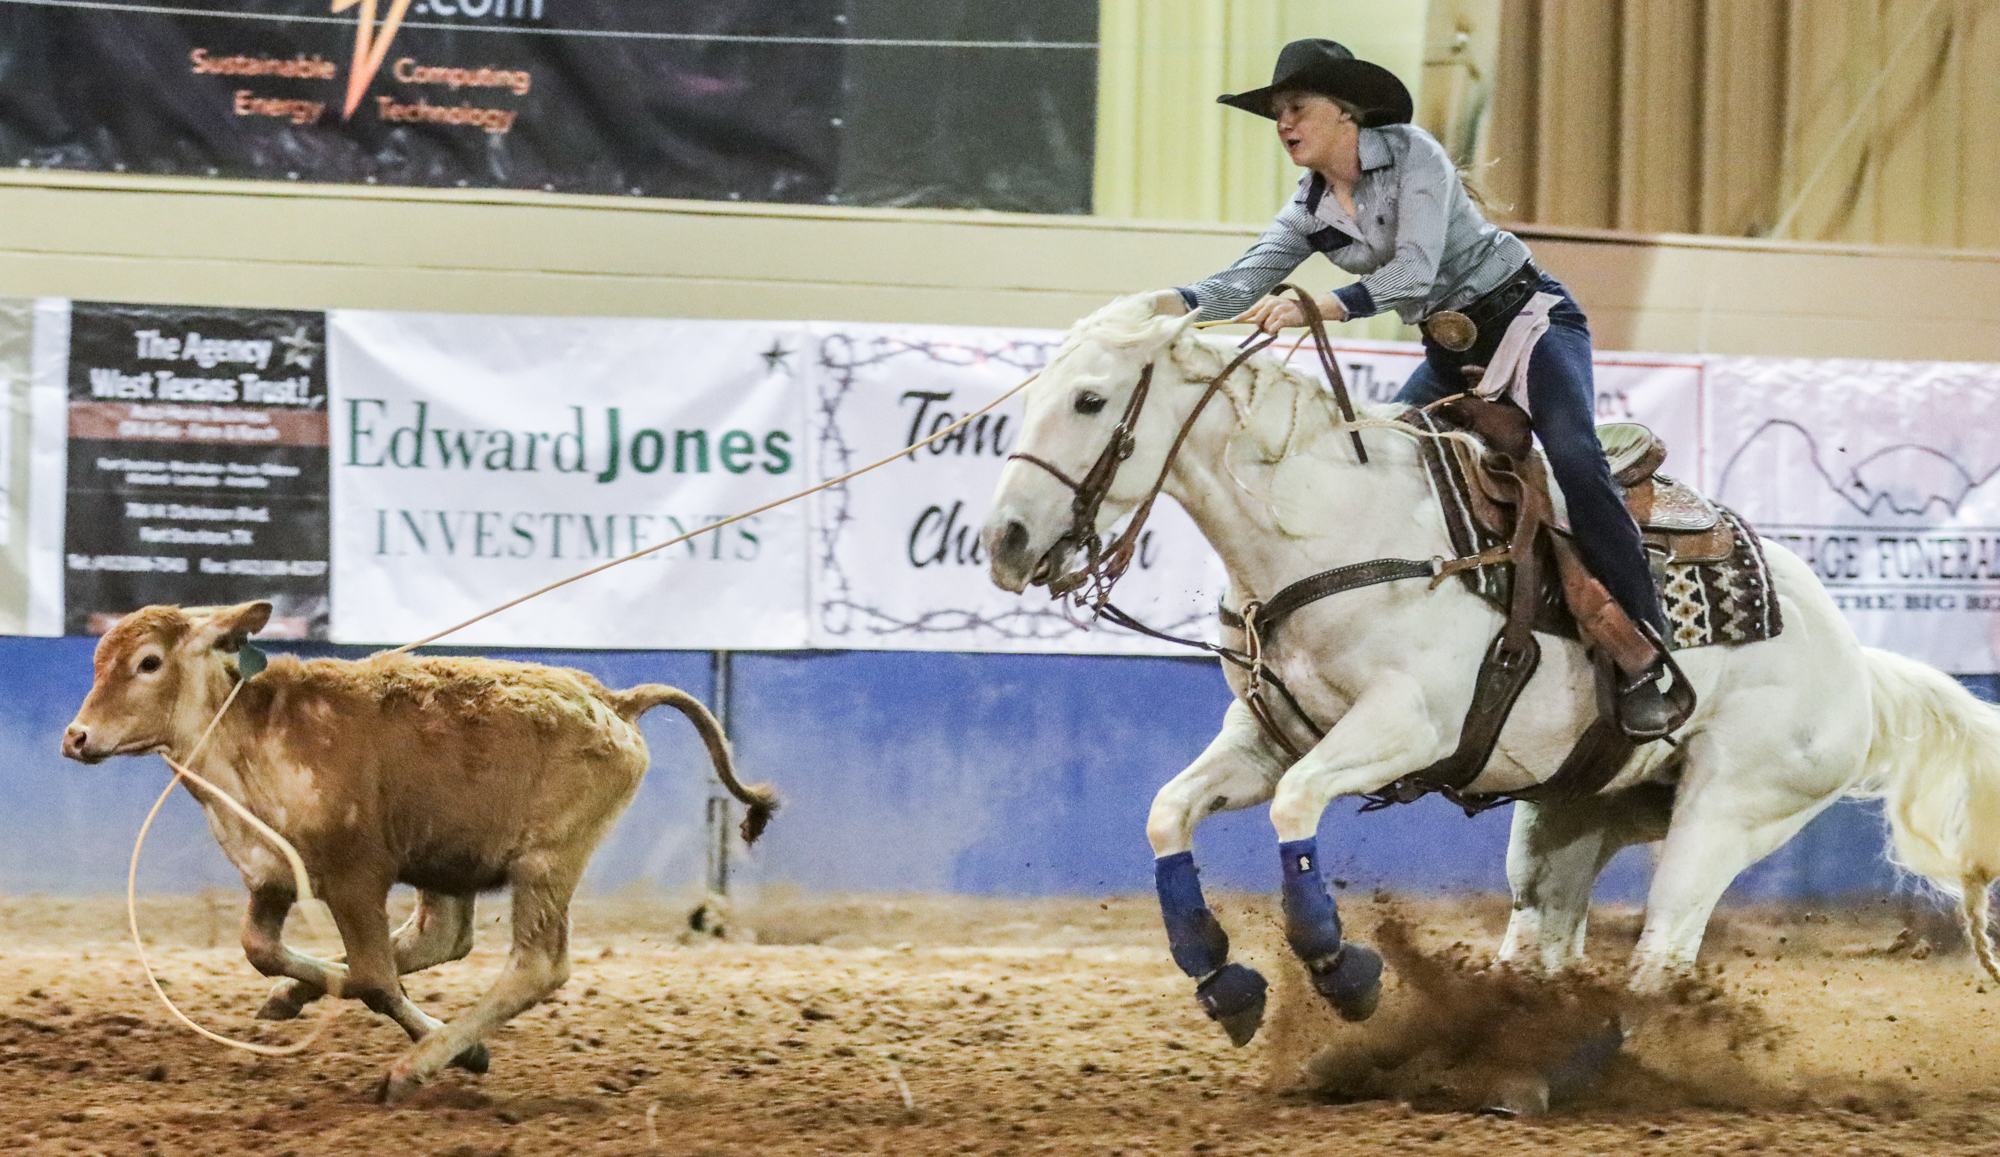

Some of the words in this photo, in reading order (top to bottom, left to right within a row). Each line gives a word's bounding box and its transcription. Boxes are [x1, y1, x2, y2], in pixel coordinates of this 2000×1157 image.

[190, 47, 336, 80] Sustainable
[394, 57, 532, 96] Computing
[234, 89, 326, 124] Energy
[378, 95, 519, 134] Technology
[134, 329, 182, 361] The
[181, 332, 273, 370] Agency
[90, 367, 154, 400] West
[374, 508, 763, 562] INVESTMENTS
